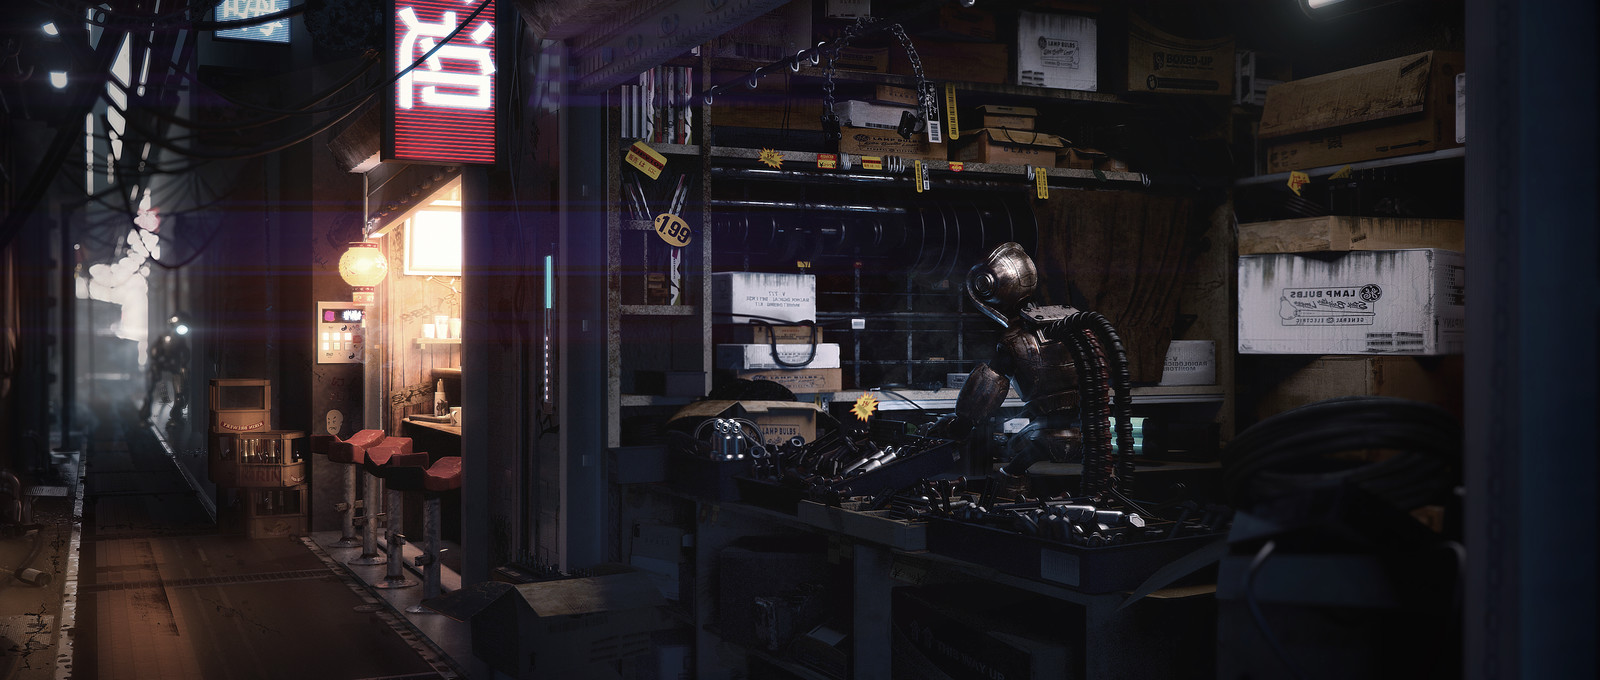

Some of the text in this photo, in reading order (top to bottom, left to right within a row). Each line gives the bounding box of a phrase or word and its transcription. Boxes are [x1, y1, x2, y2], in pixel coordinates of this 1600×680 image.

[1166, 53, 1214, 66] BOXED-UP
[762, 427, 797, 435] LAMP BULBS
